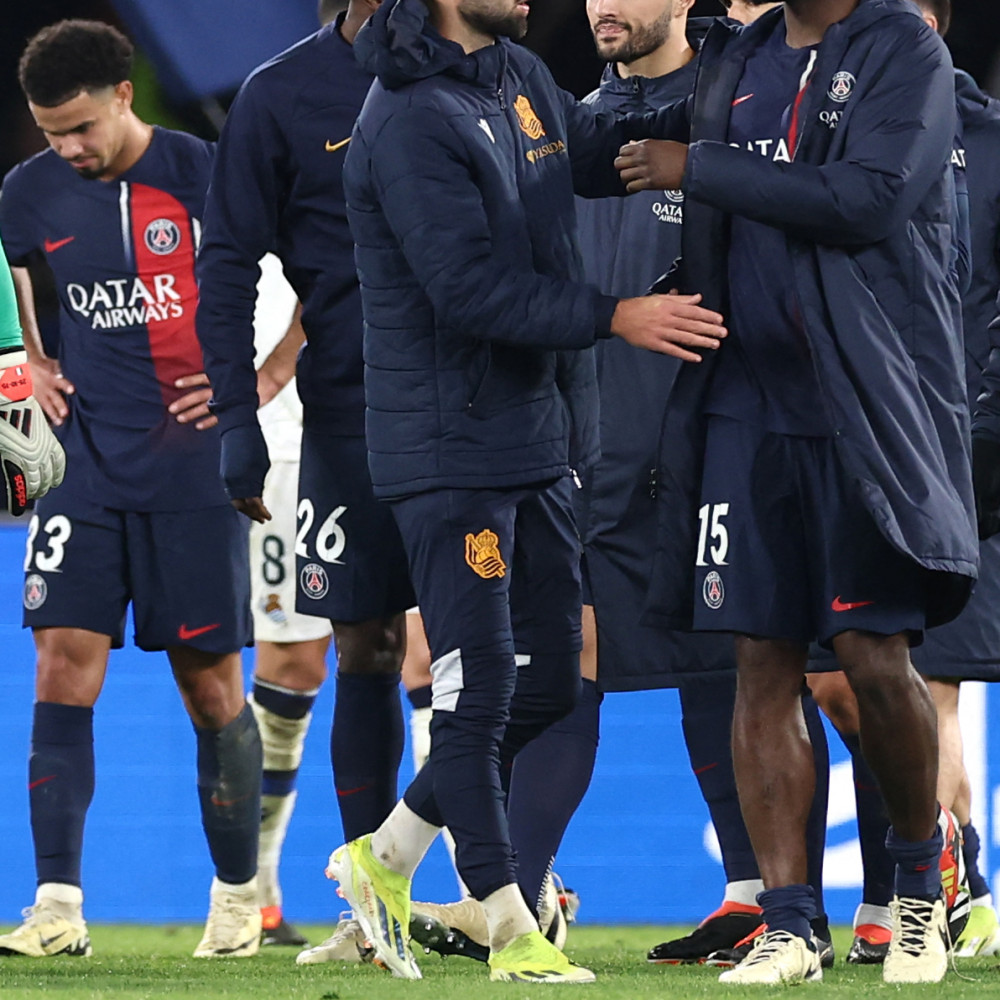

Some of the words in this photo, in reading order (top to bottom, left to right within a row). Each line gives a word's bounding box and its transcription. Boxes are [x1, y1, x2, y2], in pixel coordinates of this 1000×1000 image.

[67, 274, 181, 317] QATAR
[91, 301, 184, 330] AIRWAYS
[295, 498, 348, 565] 26
[696, 503, 730, 567] 15
[262, 534, 286, 588] 8
